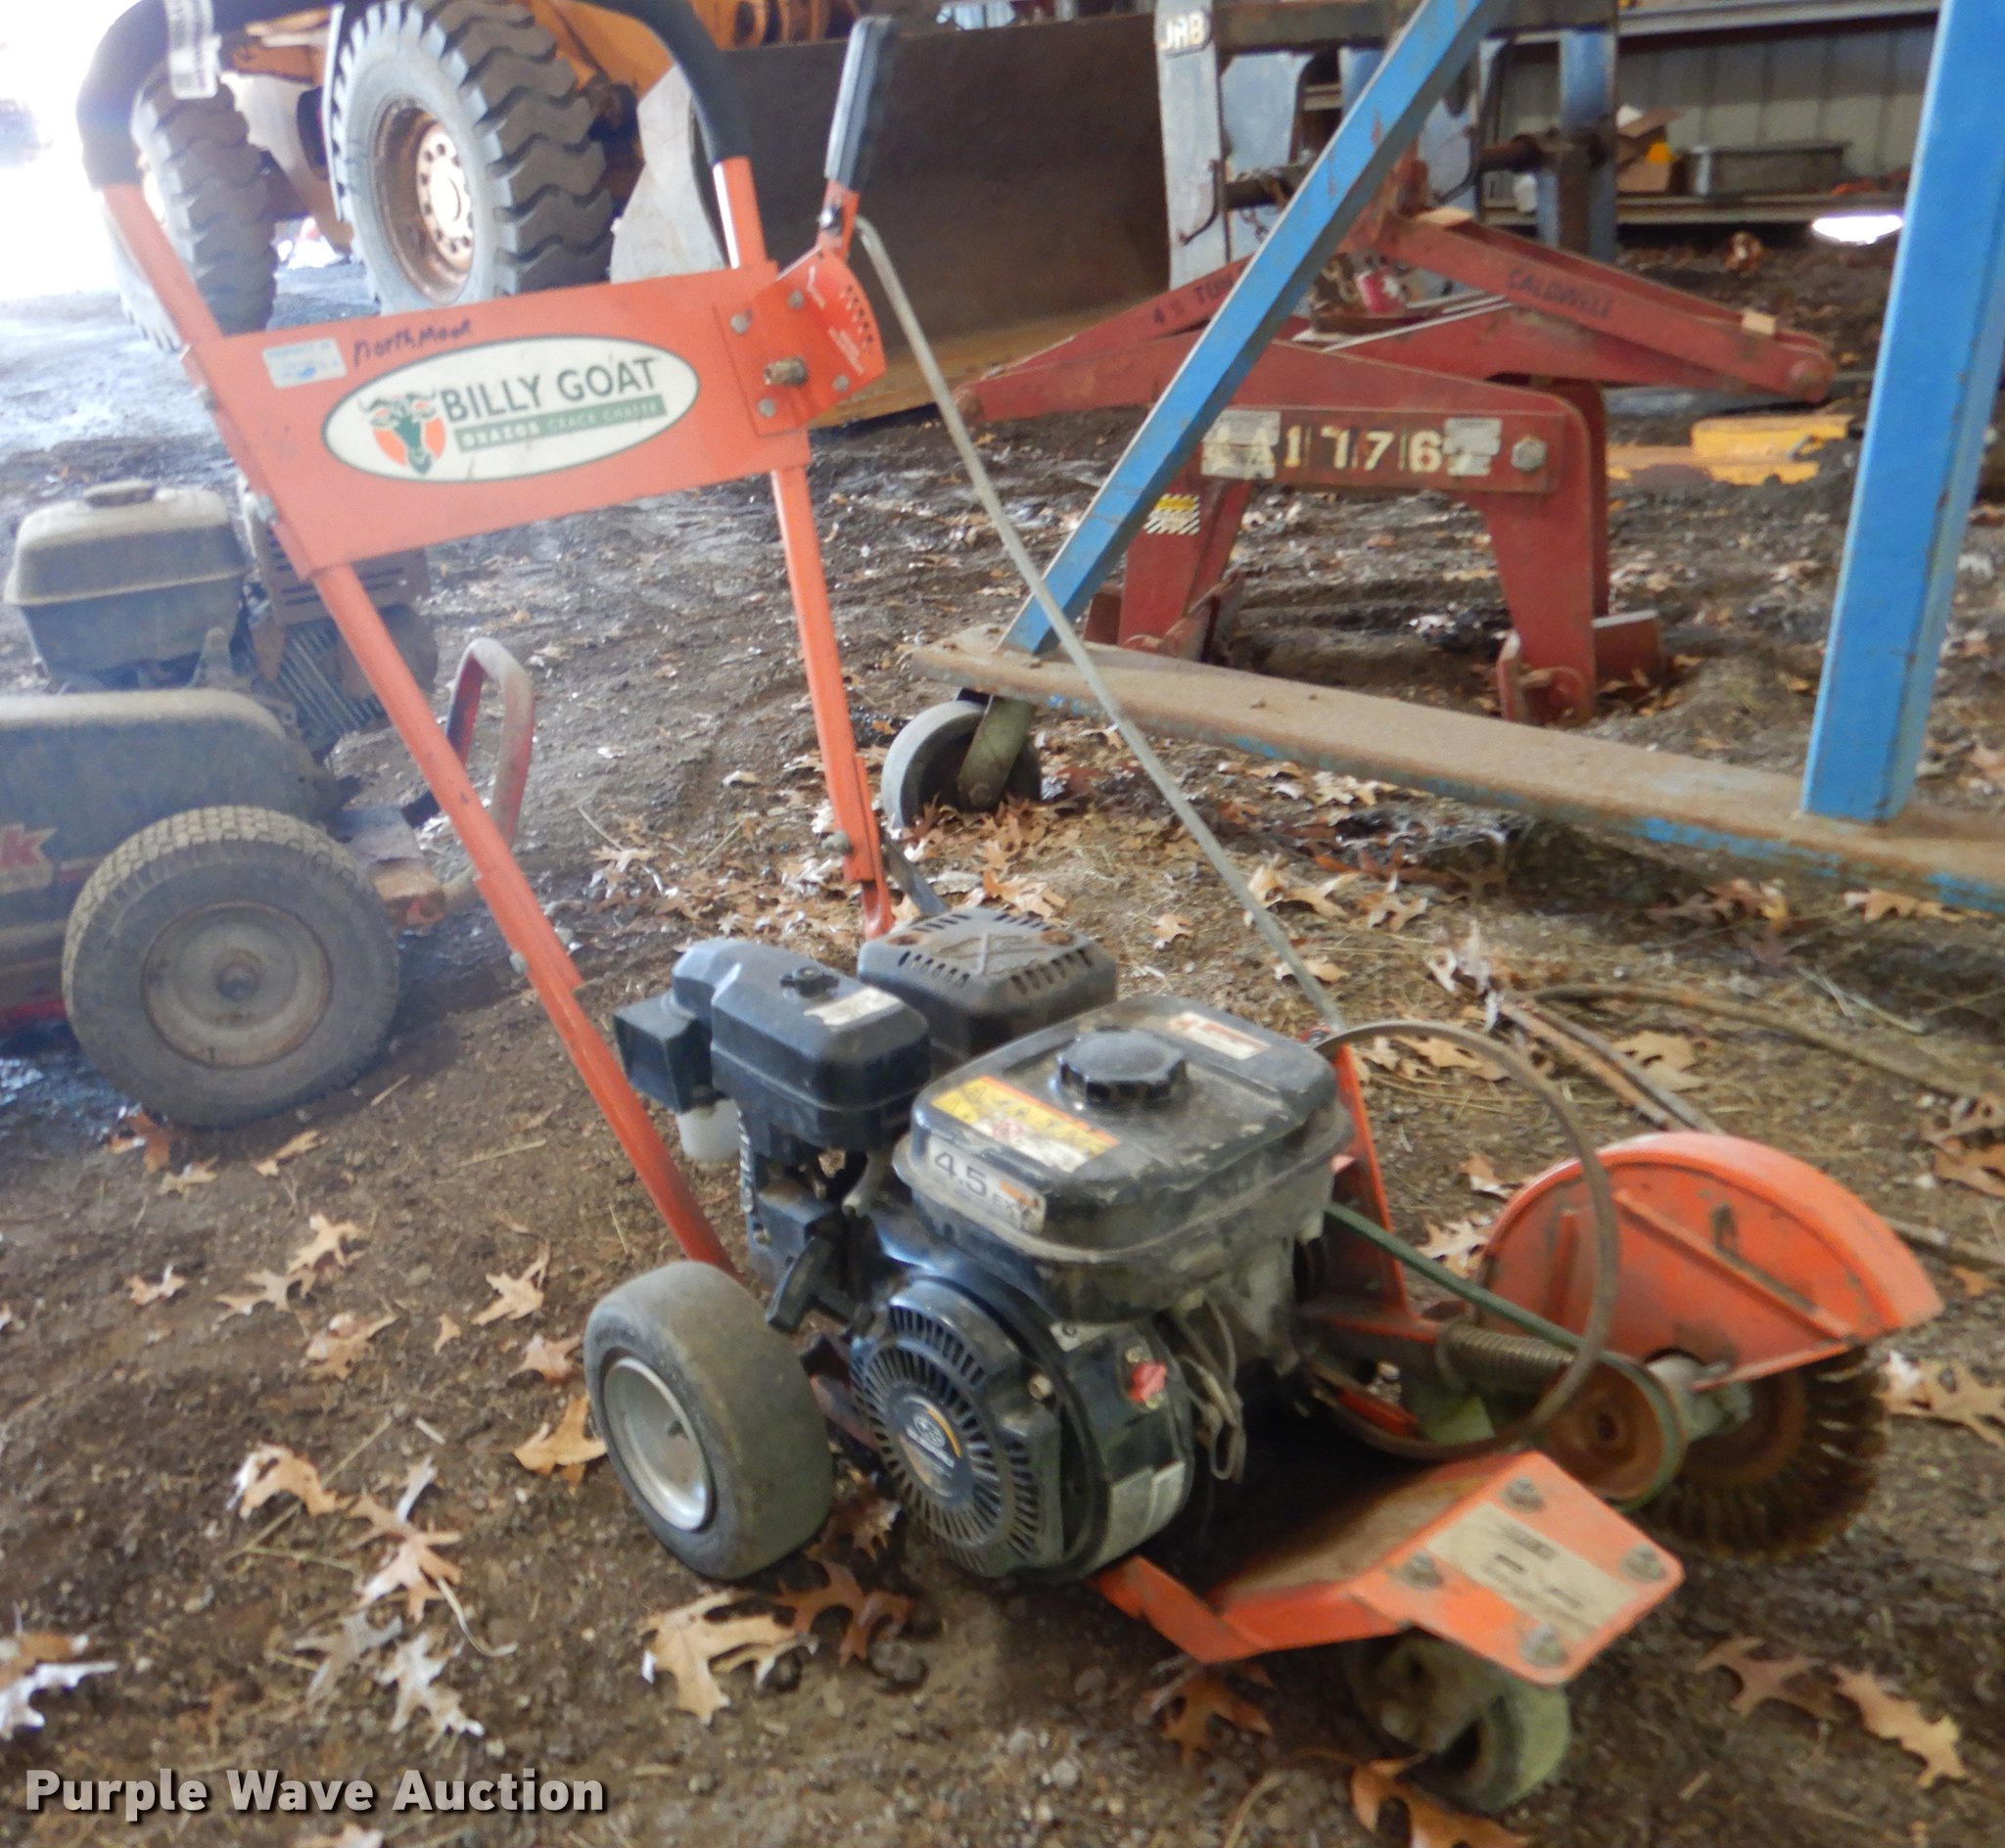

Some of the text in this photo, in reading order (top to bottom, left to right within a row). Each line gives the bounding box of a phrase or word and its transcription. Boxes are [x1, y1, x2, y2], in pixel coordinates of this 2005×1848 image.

[441, 356, 658, 423] BILLY GOAT
[546, 414, 597, 434] CRACK
[602, 401, 659, 423] CHASER
